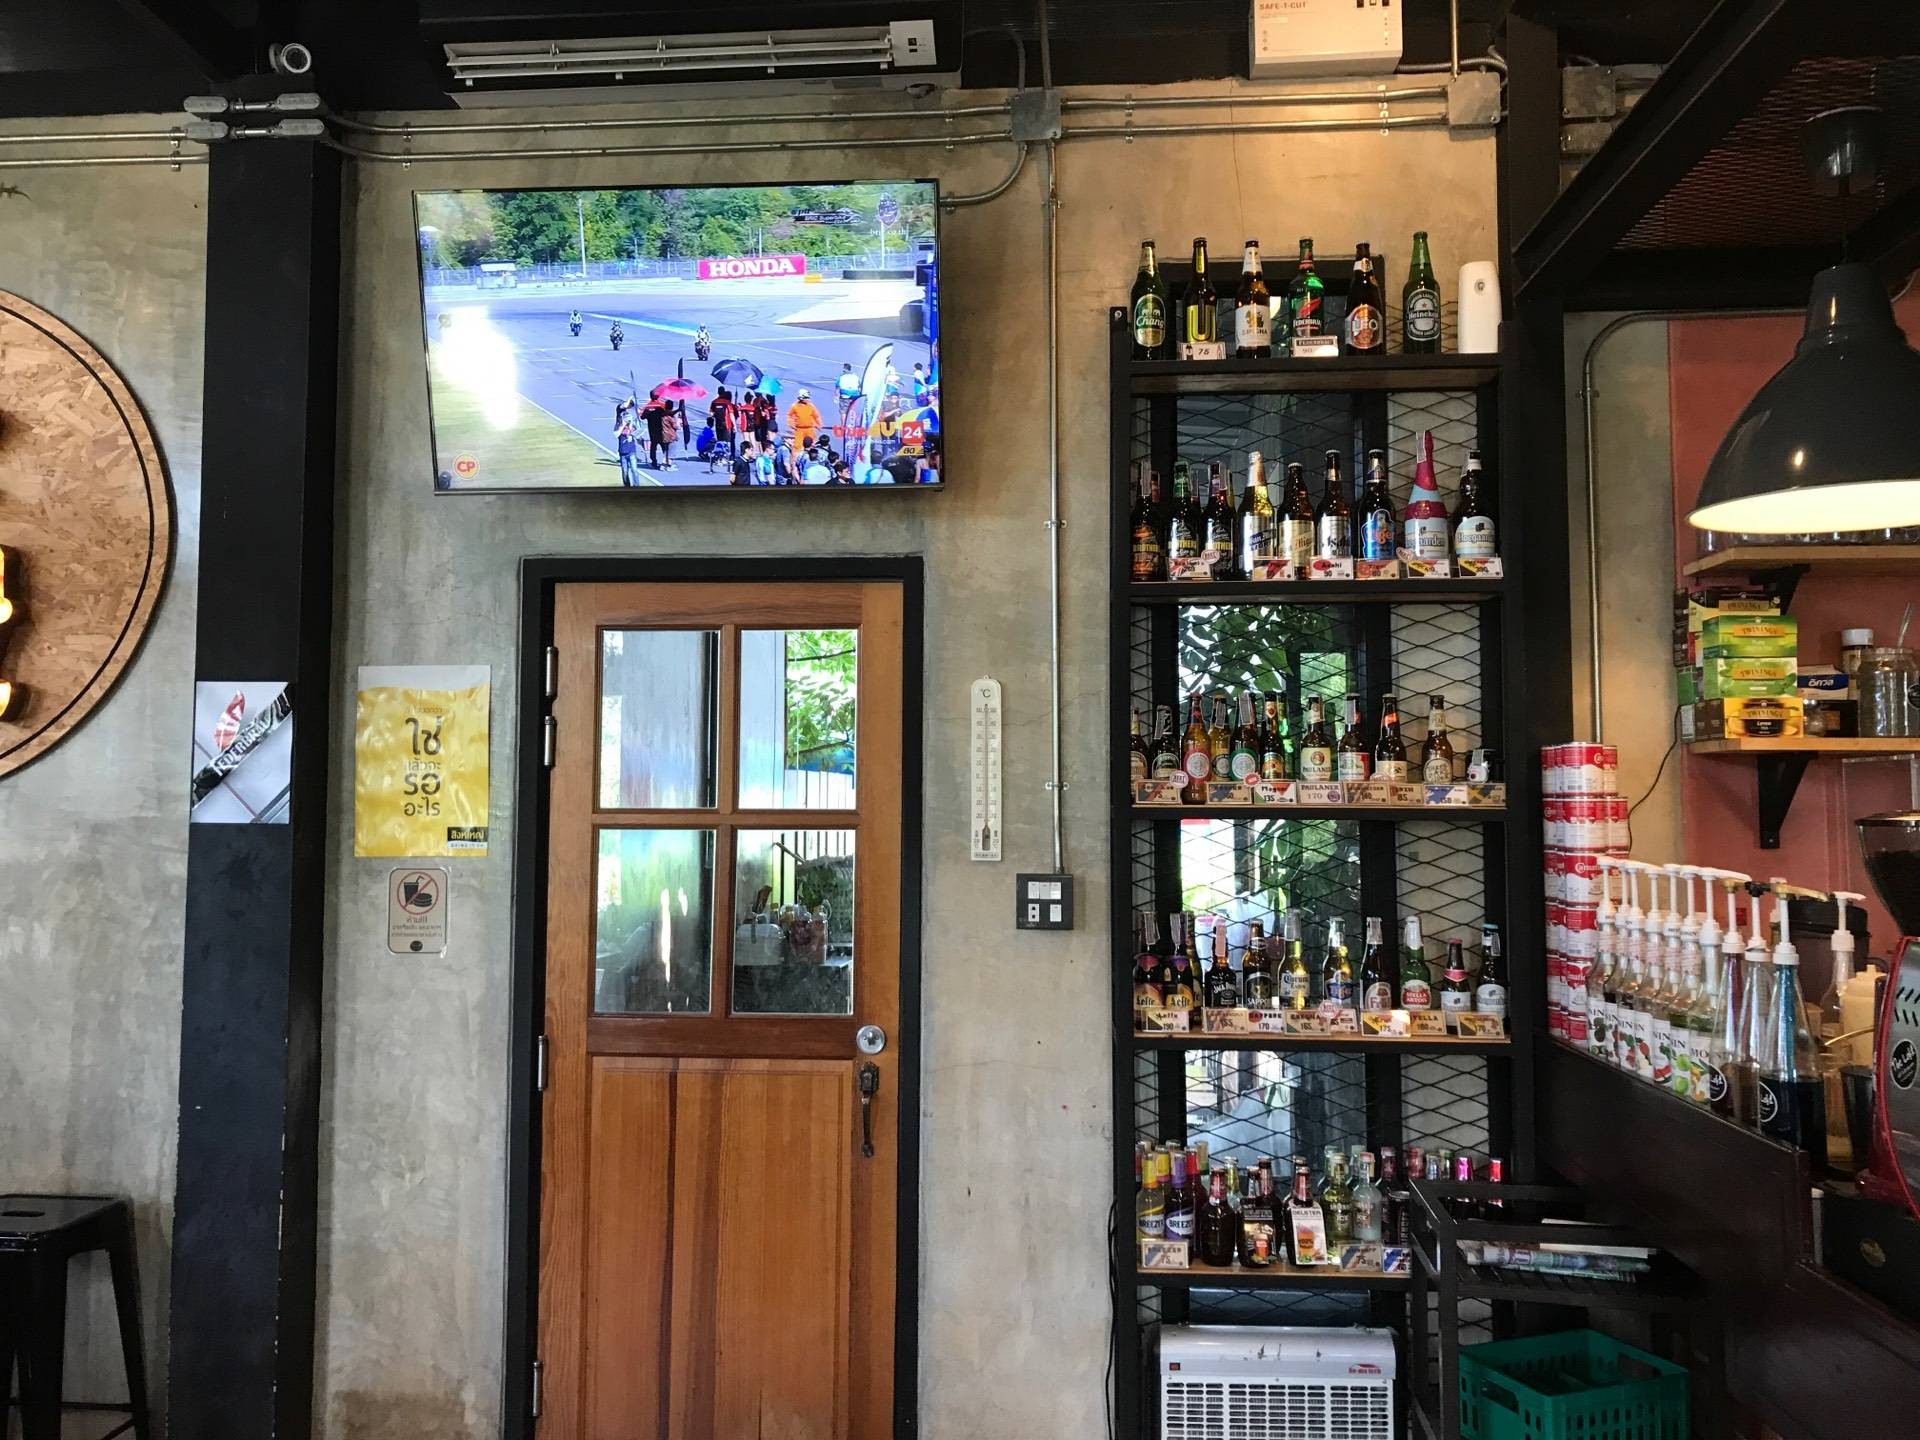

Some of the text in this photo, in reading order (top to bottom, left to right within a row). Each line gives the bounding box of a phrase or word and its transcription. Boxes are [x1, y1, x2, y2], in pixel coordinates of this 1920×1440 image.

[709, 257, 798, 278] HONDA
[1408, 310, 1439, 320] Heineken
[1136, 316, 1165, 330] Chang
[904, 425, 923, 440] 24
[457, 460, 476, 473] CP
[403, 772, 441, 797] รอ
[403, 796, 441, 817] อะไร
